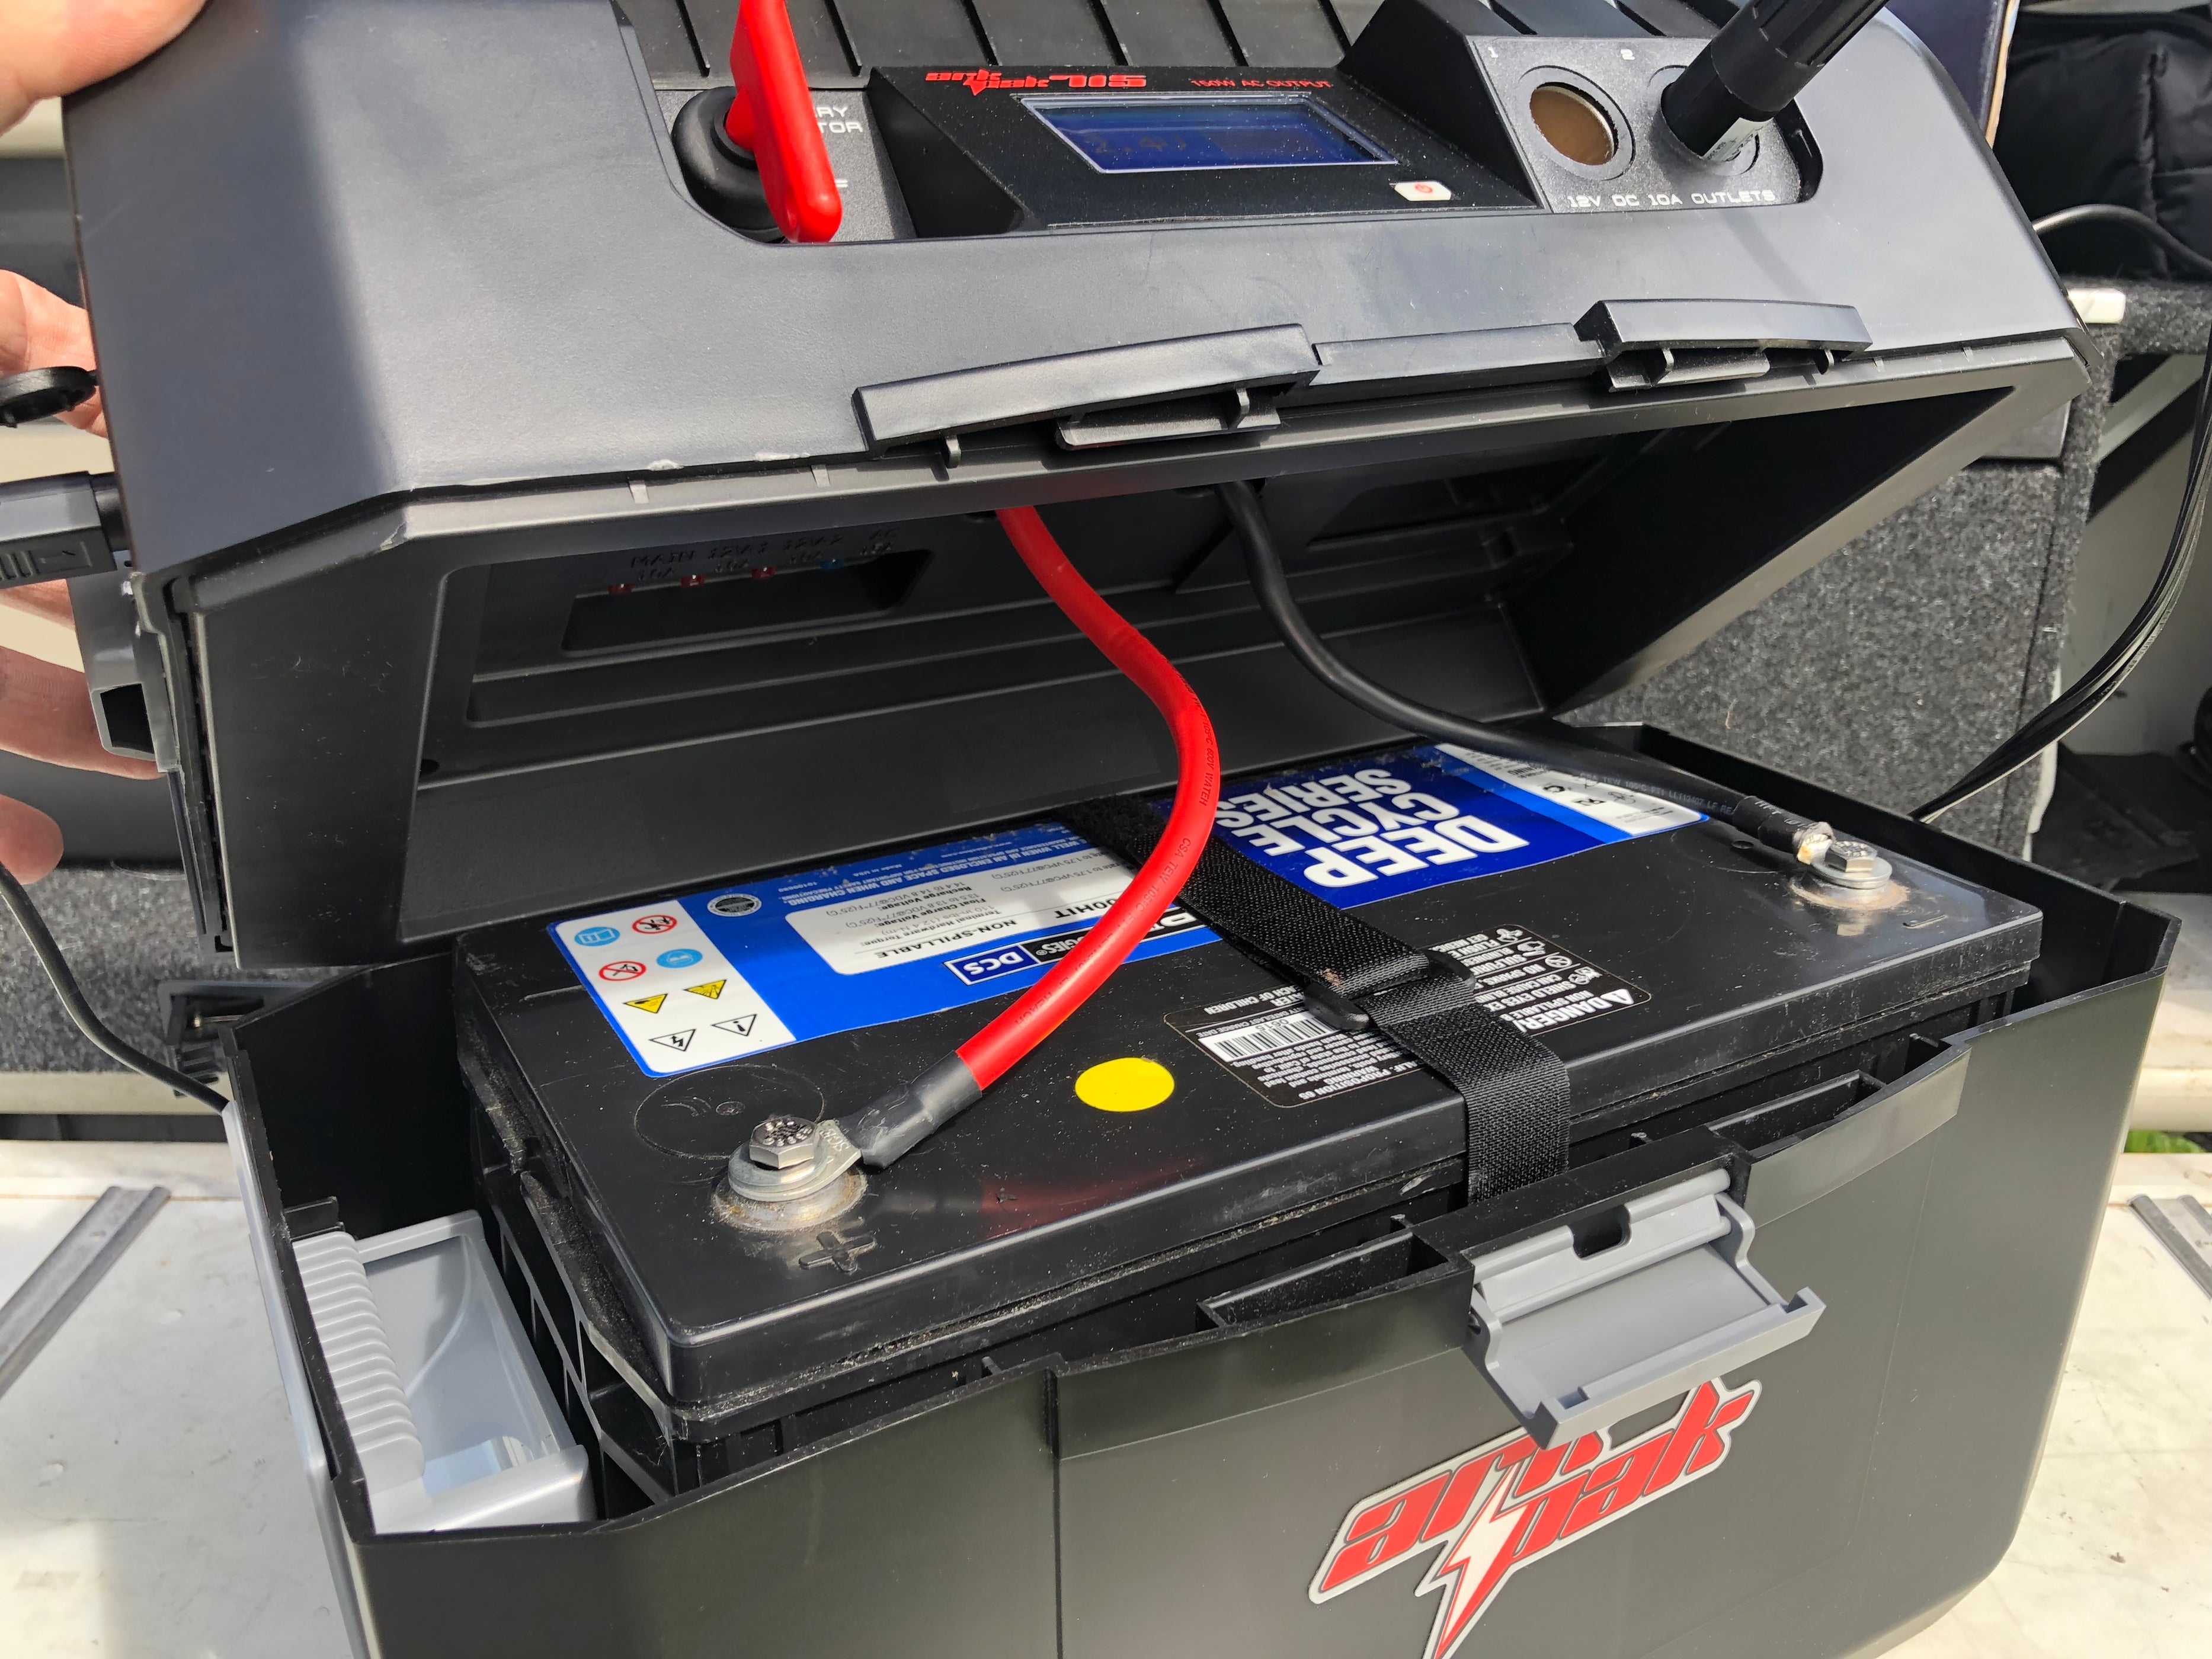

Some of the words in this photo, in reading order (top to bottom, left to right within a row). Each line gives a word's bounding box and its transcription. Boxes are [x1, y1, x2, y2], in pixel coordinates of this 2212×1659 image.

[1488, 47, 1499, 58] 1
[1620, 49, 1635, 60] 2
[1190, 79, 1236, 87] 150W
[1241, 79, 1265, 87] AC
[1266, 79, 1332, 88] OUTPUT
[1567, 194, 1601, 208] 12V
[1611, 194, 1640, 207] DC
[1648, 193, 1683, 207] 10A
[1691, 189, 1776, 205] OUTLETS
[1215, 769, 1413, 828] SERIES
[1231, 792, 1460, 857] CYCLE
[1020, 846, 1052, 856] WHEN
[1051, 840, 1079, 850] WELL
[1174, 837, 1192, 859] CSA
[1304, 814, 1530, 888] DEEP
[939, 858, 993, 873] ENCLOSED
[904, 869, 939, 880] SPACE
[1159, 861, 1179, 884] TEW
[846, 882, 880, 893] WHEN
[879, 876, 902, 886] AND
[923, 886, 972, 899] Recharge
[881, 897, 921, 909] Voltage:
[959, 898, 986, 907] Float
[920, 904, 958, 915] Charge
[878, 914, 918, 926] Voltage:
[955, 910, 1000, 923] Terminal
[903, 921, 954, 936] Hardware
[864, 935, 901, 945] Torque:
[881, 920, 1016, 957] NON-SPILLABLE
[1465, 933, 1488, 944] GET
[1457, 939, 1502, 955] FLUSH
[963, 951, 1023, 975] DCS
[1522, 963, 1546, 974] NO
[1478, 969, 1526, 985] SPARKS,
[1535, 973, 1562, 985] CAN
[1502, 980, 1541, 995] CAUSE
[1531, 980, 1576, 998] SHIELD
[1258, 991, 1275, 1001] OF
[1270, 991, 1304, 1007] ATER
[1472, 989, 1508, 1003] BLIND
[1500, 992, 1536, 1007] EYES
[1564, 989, 1594, 1003] NON
[1203, 996, 1259, 1014] CHILDREN
[1509, 997, 1569, 1019] SPILLABLE
[1249, 1010, 1289, 1024] DATE/LAST
[1216, 1021, 1250, 1033] CHARGE
[1254, 1019, 1289, 1032] 0615
[1195, 1029, 1218, 1038] DATE
[1320, 1033, 1347, 1044] Wash
[1293, 1040, 1323, 1051] hands
[1323, 1037, 1353, 1049] cancer
[1331, 1045, 1350, 1053] the
[1355, 1044, 1378, 1054] lead
[1272, 1048, 1294, 1058] after
[1305, 1046, 1324, 1055] and
[1309, 1050, 1333, 1060] state
[1230, 1053, 1274, 1067] handling.
[1251, 1051, 1307, 1069] reproductive
[1273, 1059, 1301, 1070] Calif.
[1302, 1050, 1356, 1068] compounds,
[1318, 1053, 1370, 1071] accessories
[1348, 1057, 1378, 1068] posts,
[1257, 1064, 1304, 1081] chemicals
[1284, 1068, 1319, 1081] contain
[1306, 1066, 1351, 1081] terminals
[1323, 1065, 1379, 1085] WARNING
[1263, 1077, 1287, 1088] lead
[1288, 1078, 1307, 1088] and
[1314, 1068, 1391, 1095] PROPOSITION
[1298, 1090, 1315, 1100] 65
